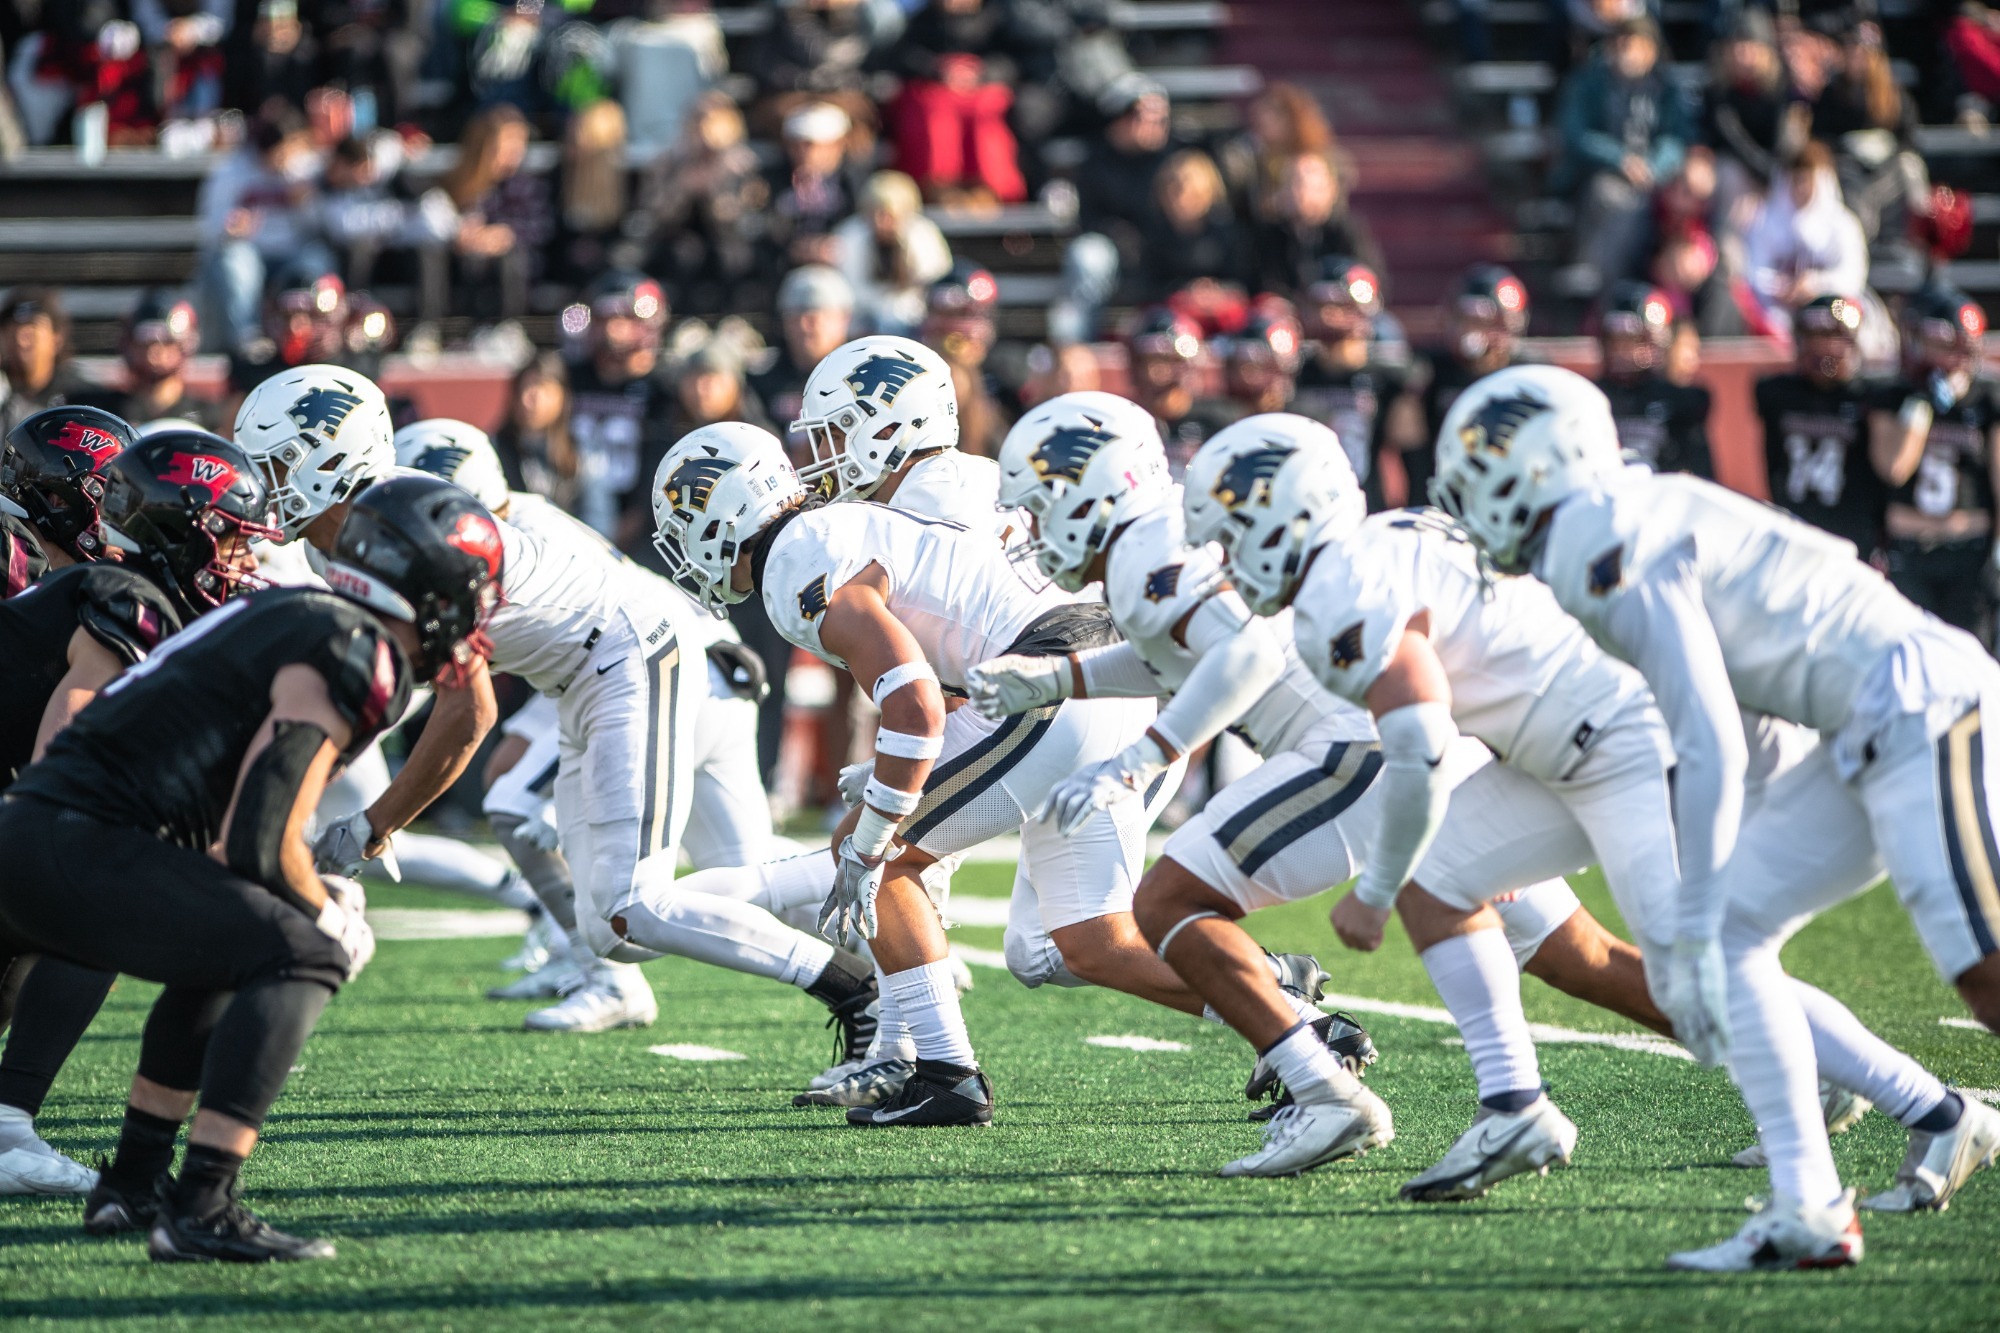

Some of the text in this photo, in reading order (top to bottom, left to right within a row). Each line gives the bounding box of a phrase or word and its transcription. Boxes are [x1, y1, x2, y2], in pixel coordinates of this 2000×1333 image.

[79, 429, 115, 452] W
[191, 457, 229, 484] W
[764, 475, 779, 491] 19
